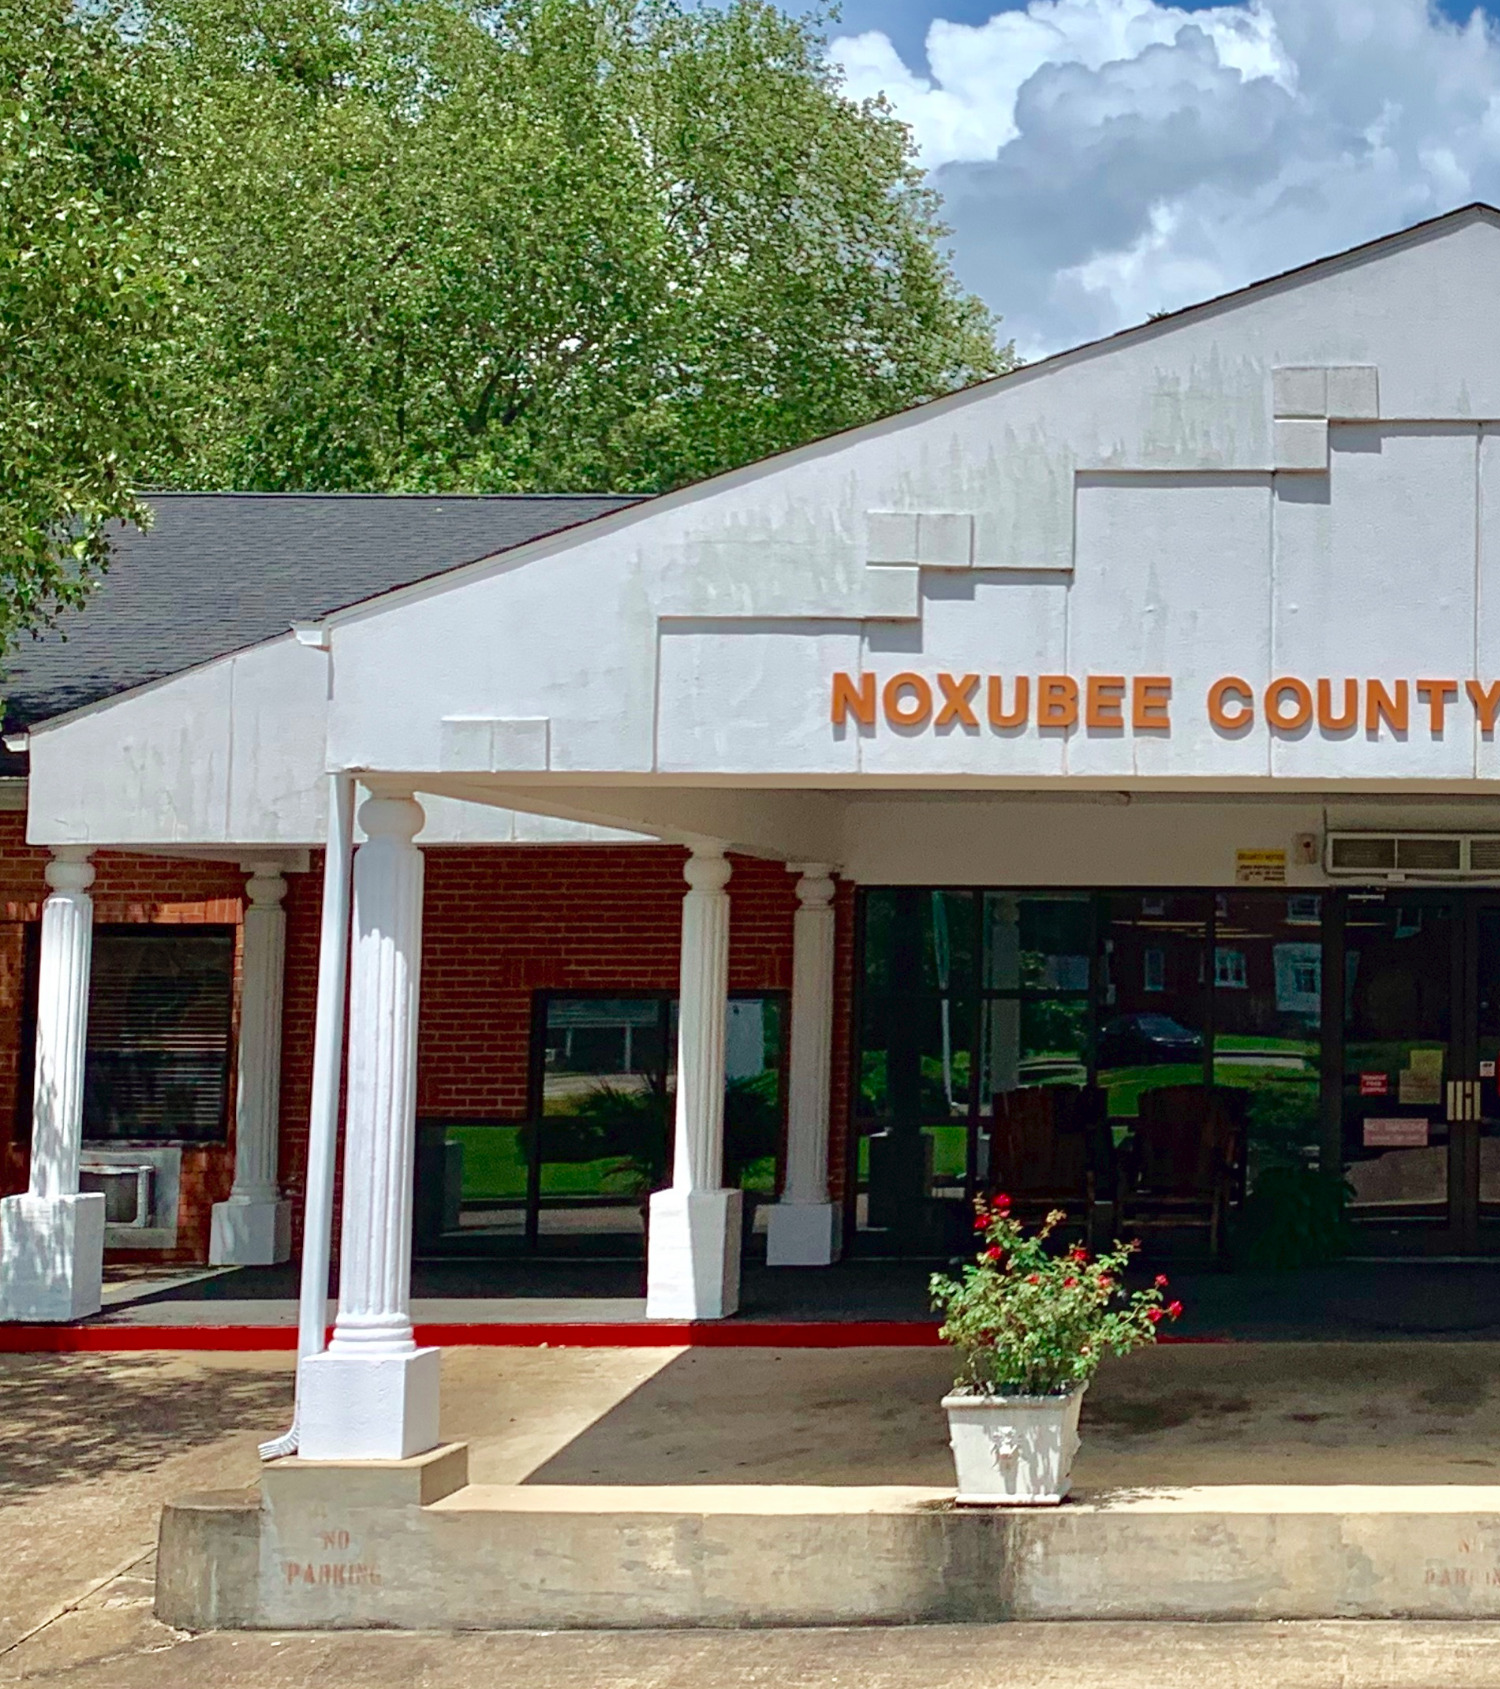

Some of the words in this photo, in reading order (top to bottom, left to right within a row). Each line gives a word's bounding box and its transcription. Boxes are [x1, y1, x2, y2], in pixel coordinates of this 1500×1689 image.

[831, 672, 1172, 728] NOXUBEE
[322, 1530, 350, 1551] NO
[286, 1562, 383, 1586] PARKING
